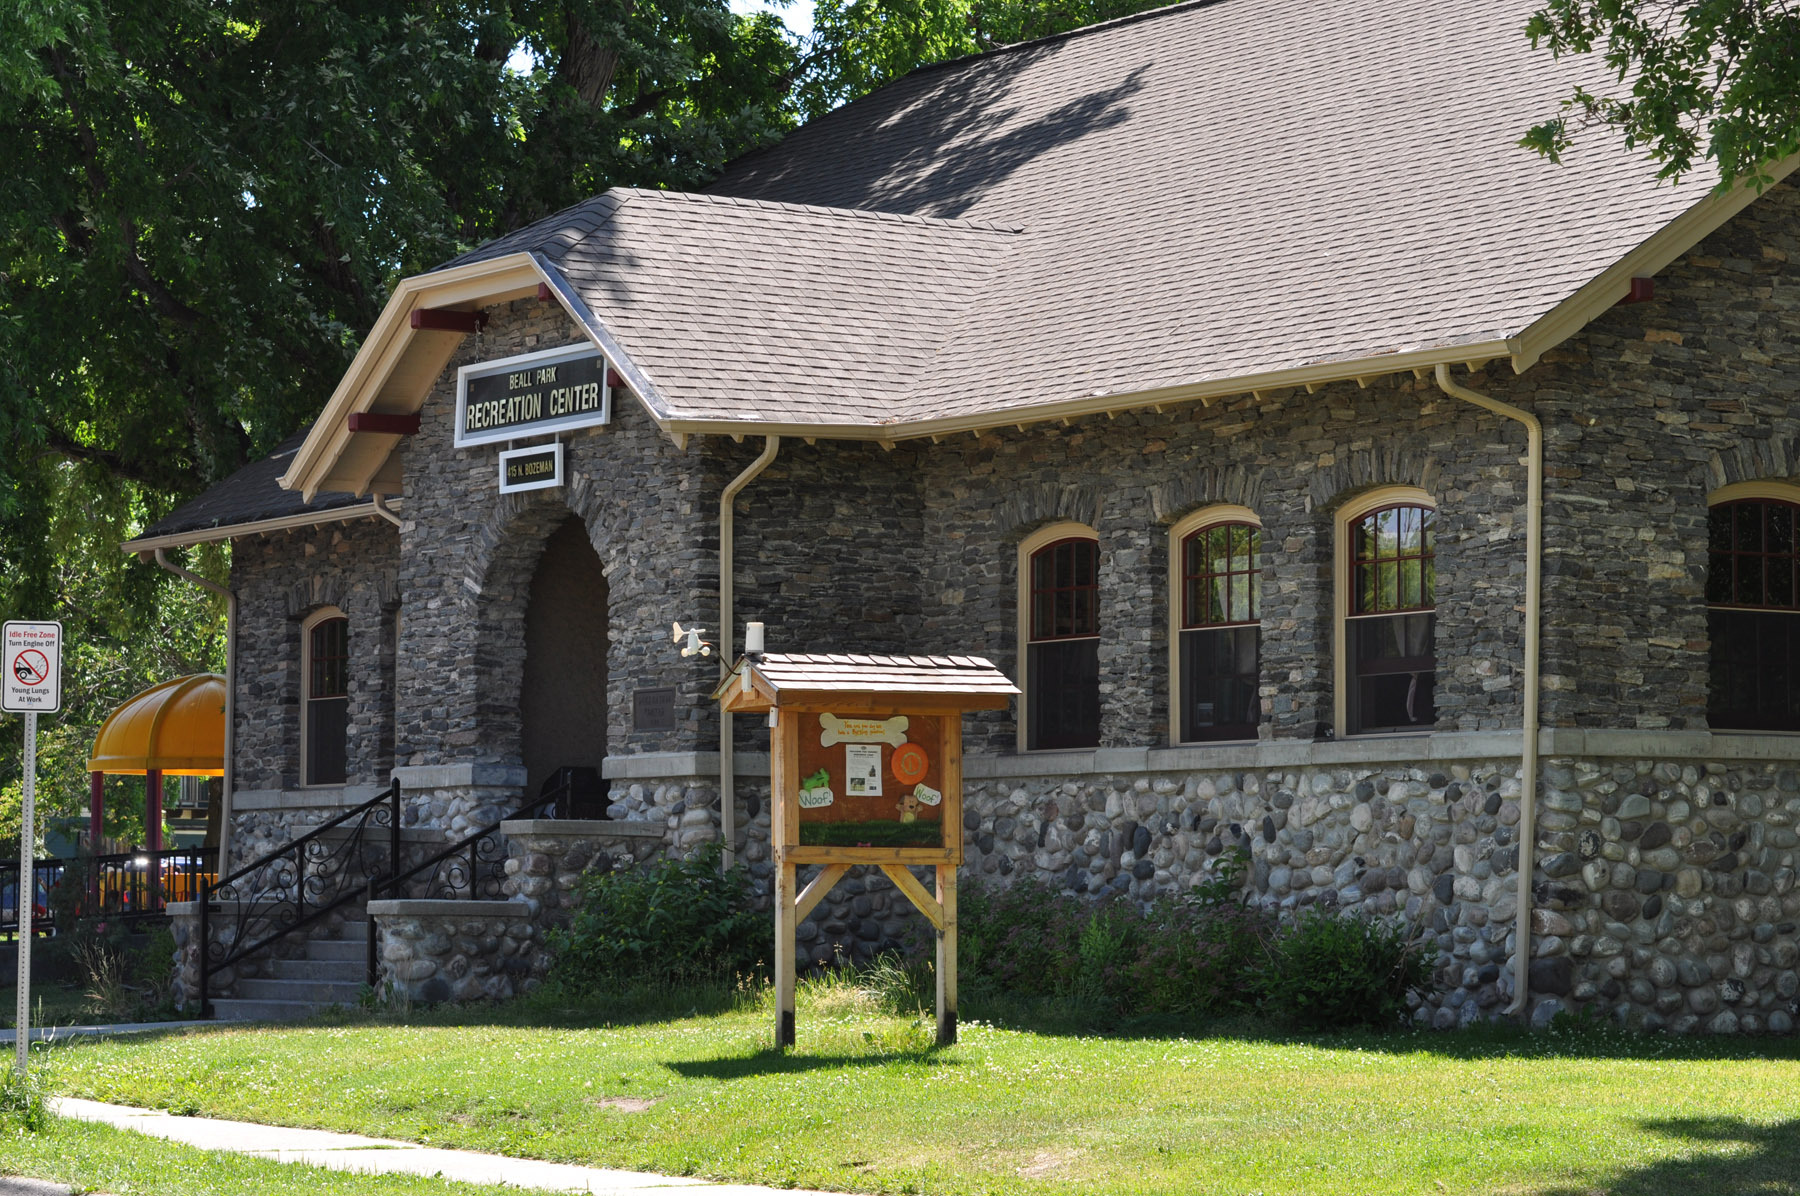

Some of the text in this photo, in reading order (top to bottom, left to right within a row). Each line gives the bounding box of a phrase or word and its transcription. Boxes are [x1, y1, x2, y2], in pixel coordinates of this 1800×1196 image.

[510, 367, 557, 390] BEALL PARK
[466, 383, 598, 429] RECREATION CENTER
[525, 460, 553, 476] BOZEMAN
[39, 631, 55, 639] Zone
[24, 640, 44, 648] Engine
[12, 687, 30, 695] Young
